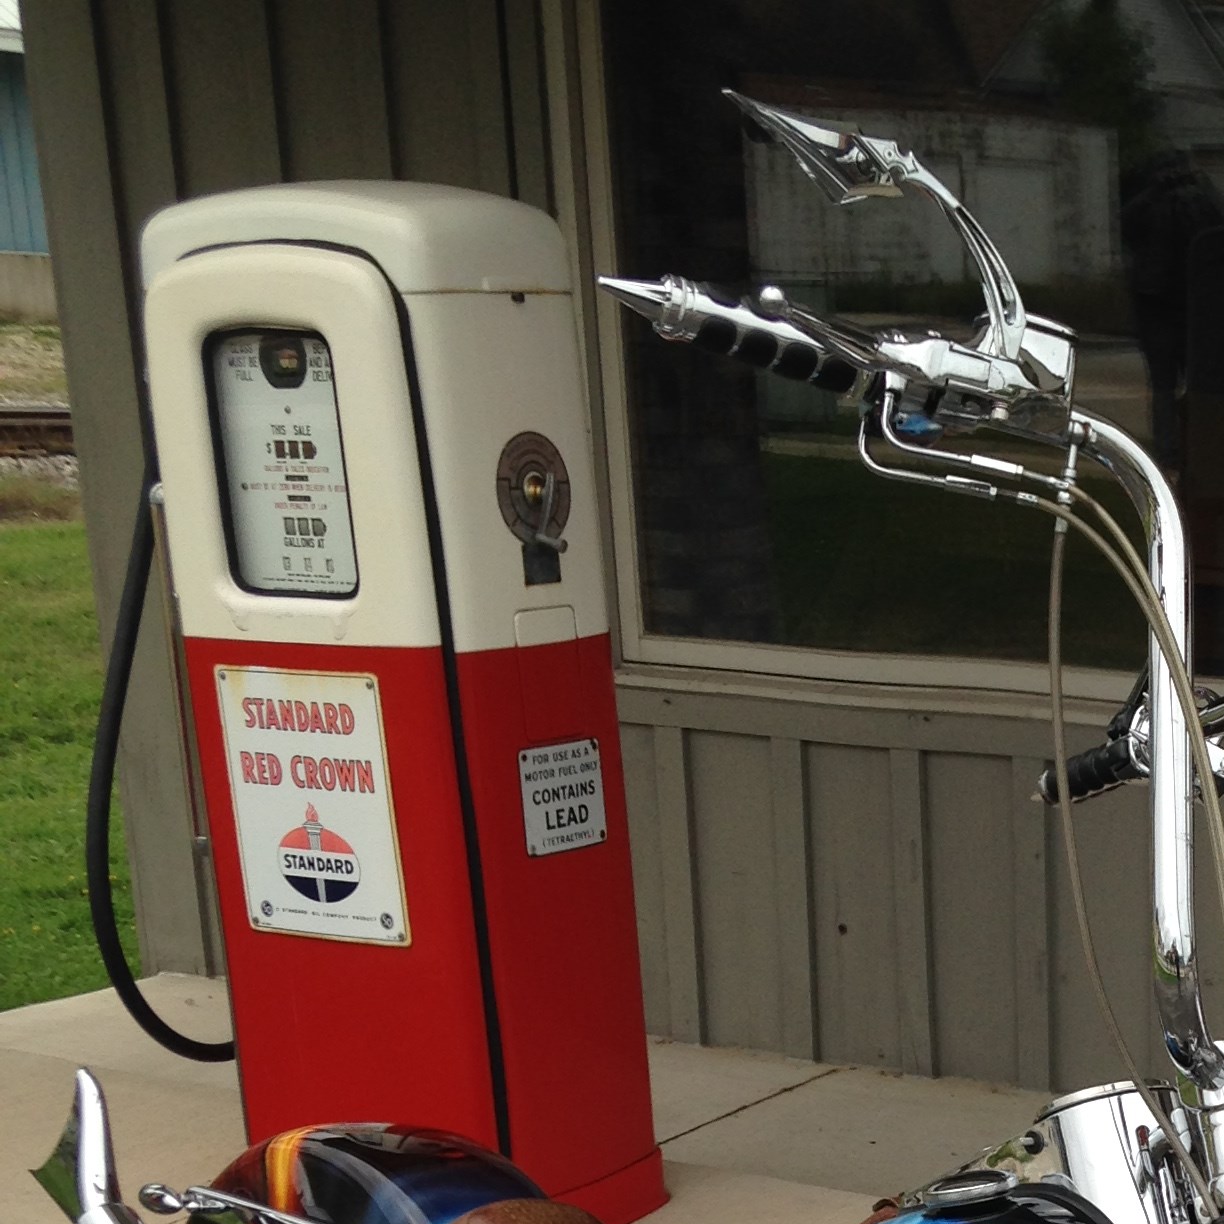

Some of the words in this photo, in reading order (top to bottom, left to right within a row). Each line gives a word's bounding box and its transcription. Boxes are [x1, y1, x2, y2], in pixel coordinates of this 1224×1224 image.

[270, 424, 286, 436] THIS
[293, 425, 312, 437] SALE
[284, 536, 315, 549] GALLONS
[242, 697, 356, 735] STANDARD
[532, 753, 549, 766] FOR
[552, 750, 568, 762] USE
[571, 748, 581, 759] AS
[584, 747, 590, 756] A
[240, 751, 283, 787] RED
[290, 755, 376, 794] CROWN
[524, 769, 555, 782] MOTOR
[558, 764, 578, 778] FUEL
[580, 761, 598, 773] ONLY
[532, 779, 596, 806] CONTAINS
[545, 804, 589, 831] LEAD
[283, 853, 355, 876] STANDARD
